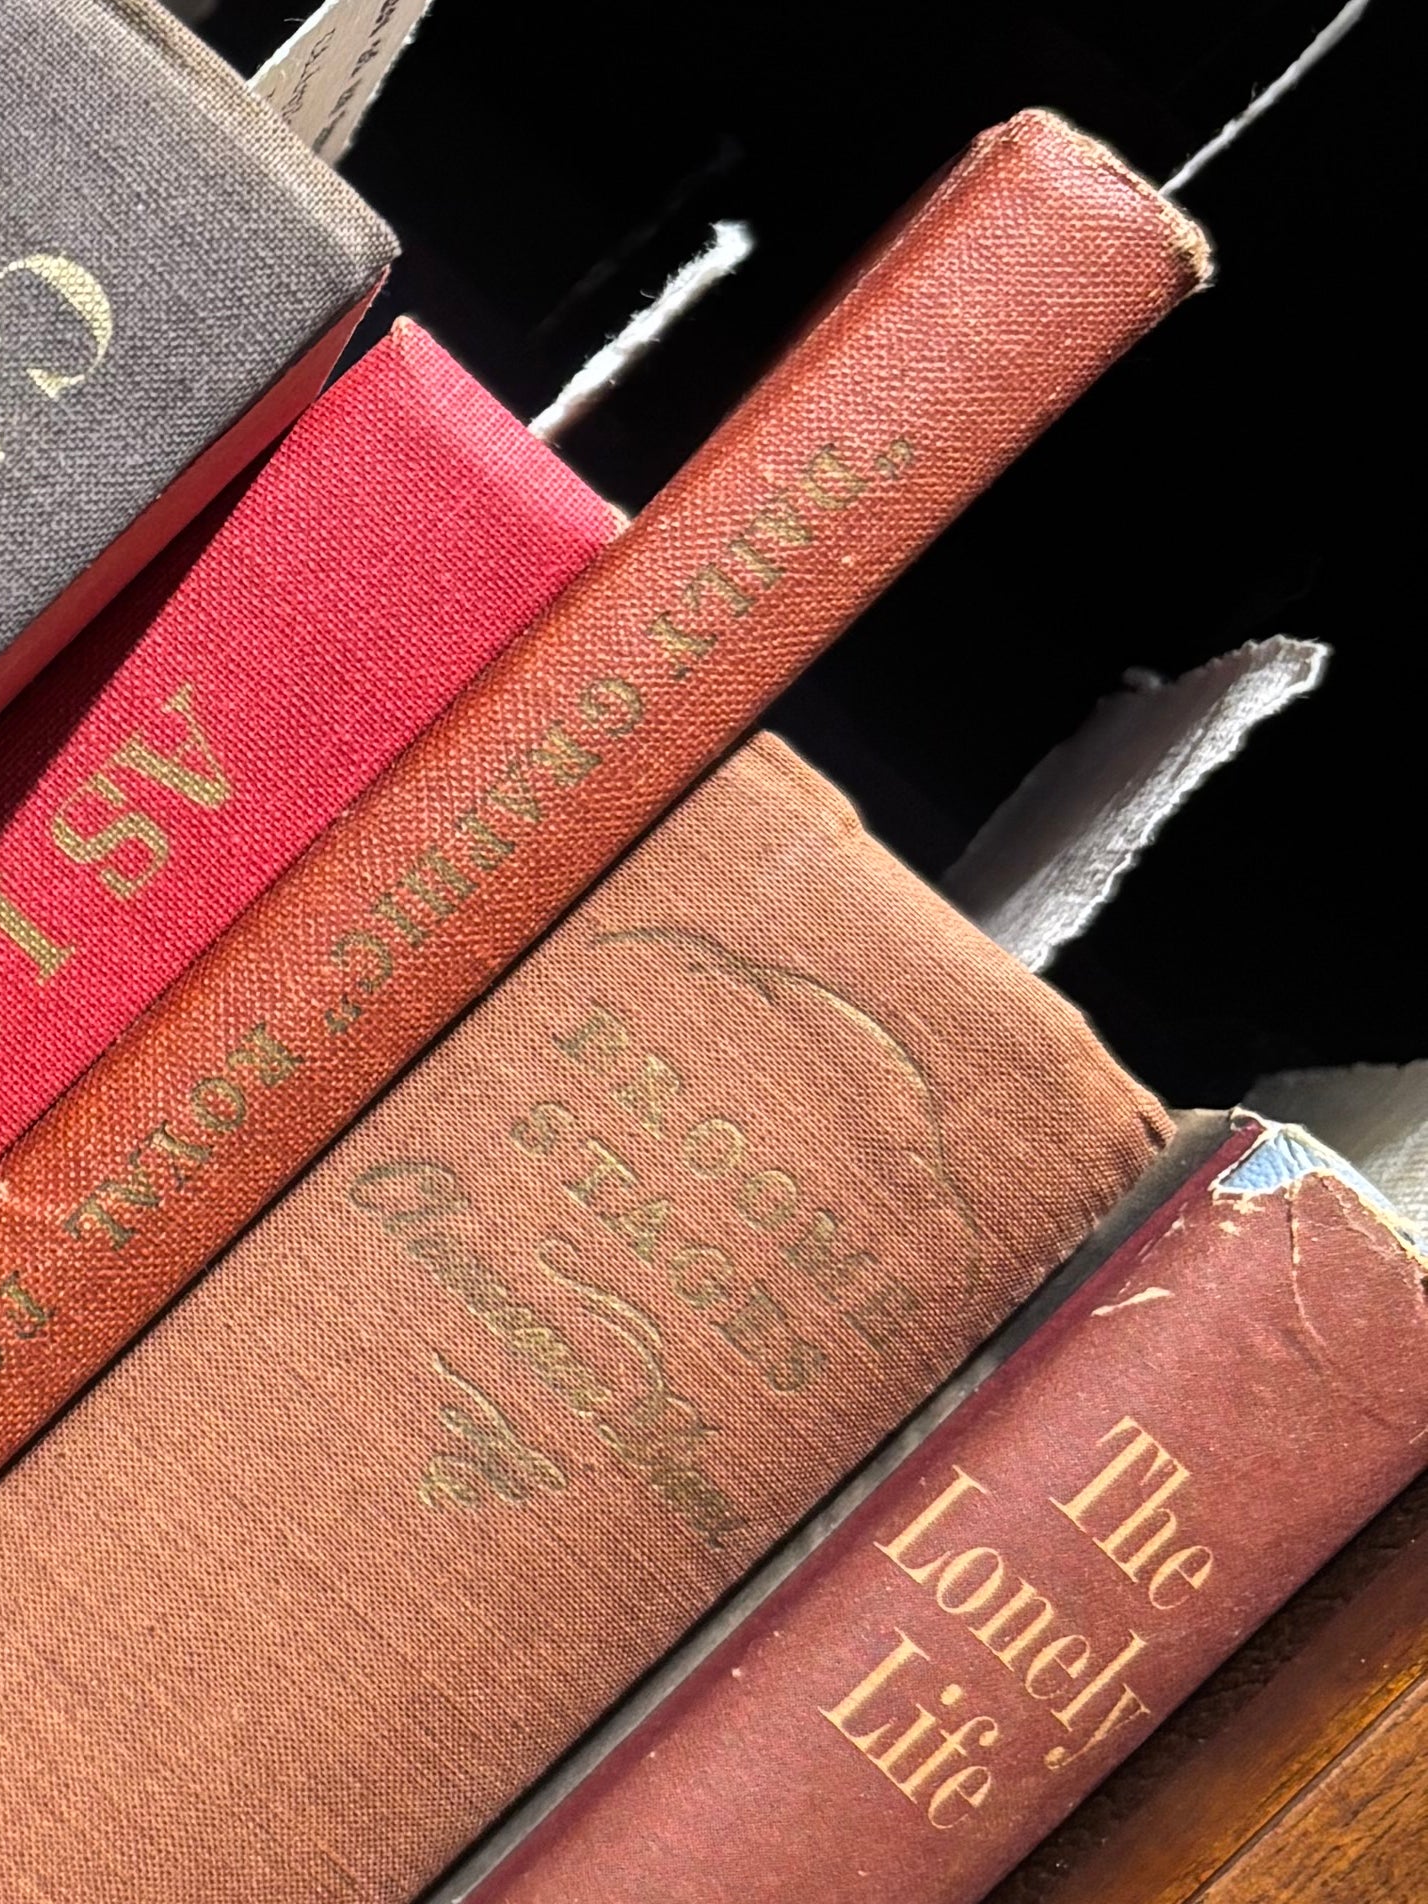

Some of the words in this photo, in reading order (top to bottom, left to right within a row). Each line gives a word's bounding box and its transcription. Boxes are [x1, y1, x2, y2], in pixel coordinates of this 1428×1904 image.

[50, 682, 236, 903] AS
[64, 1020, 304, 1253] ROYAL
[507, 1101, 828, 1394] STAGES
[553, 1001, 918, 1353] BROOME
[873, 1464, 1151, 1771] Lonely
[1048, 1414, 1216, 1611] The
[817, 1627, 1000, 1830] Life
